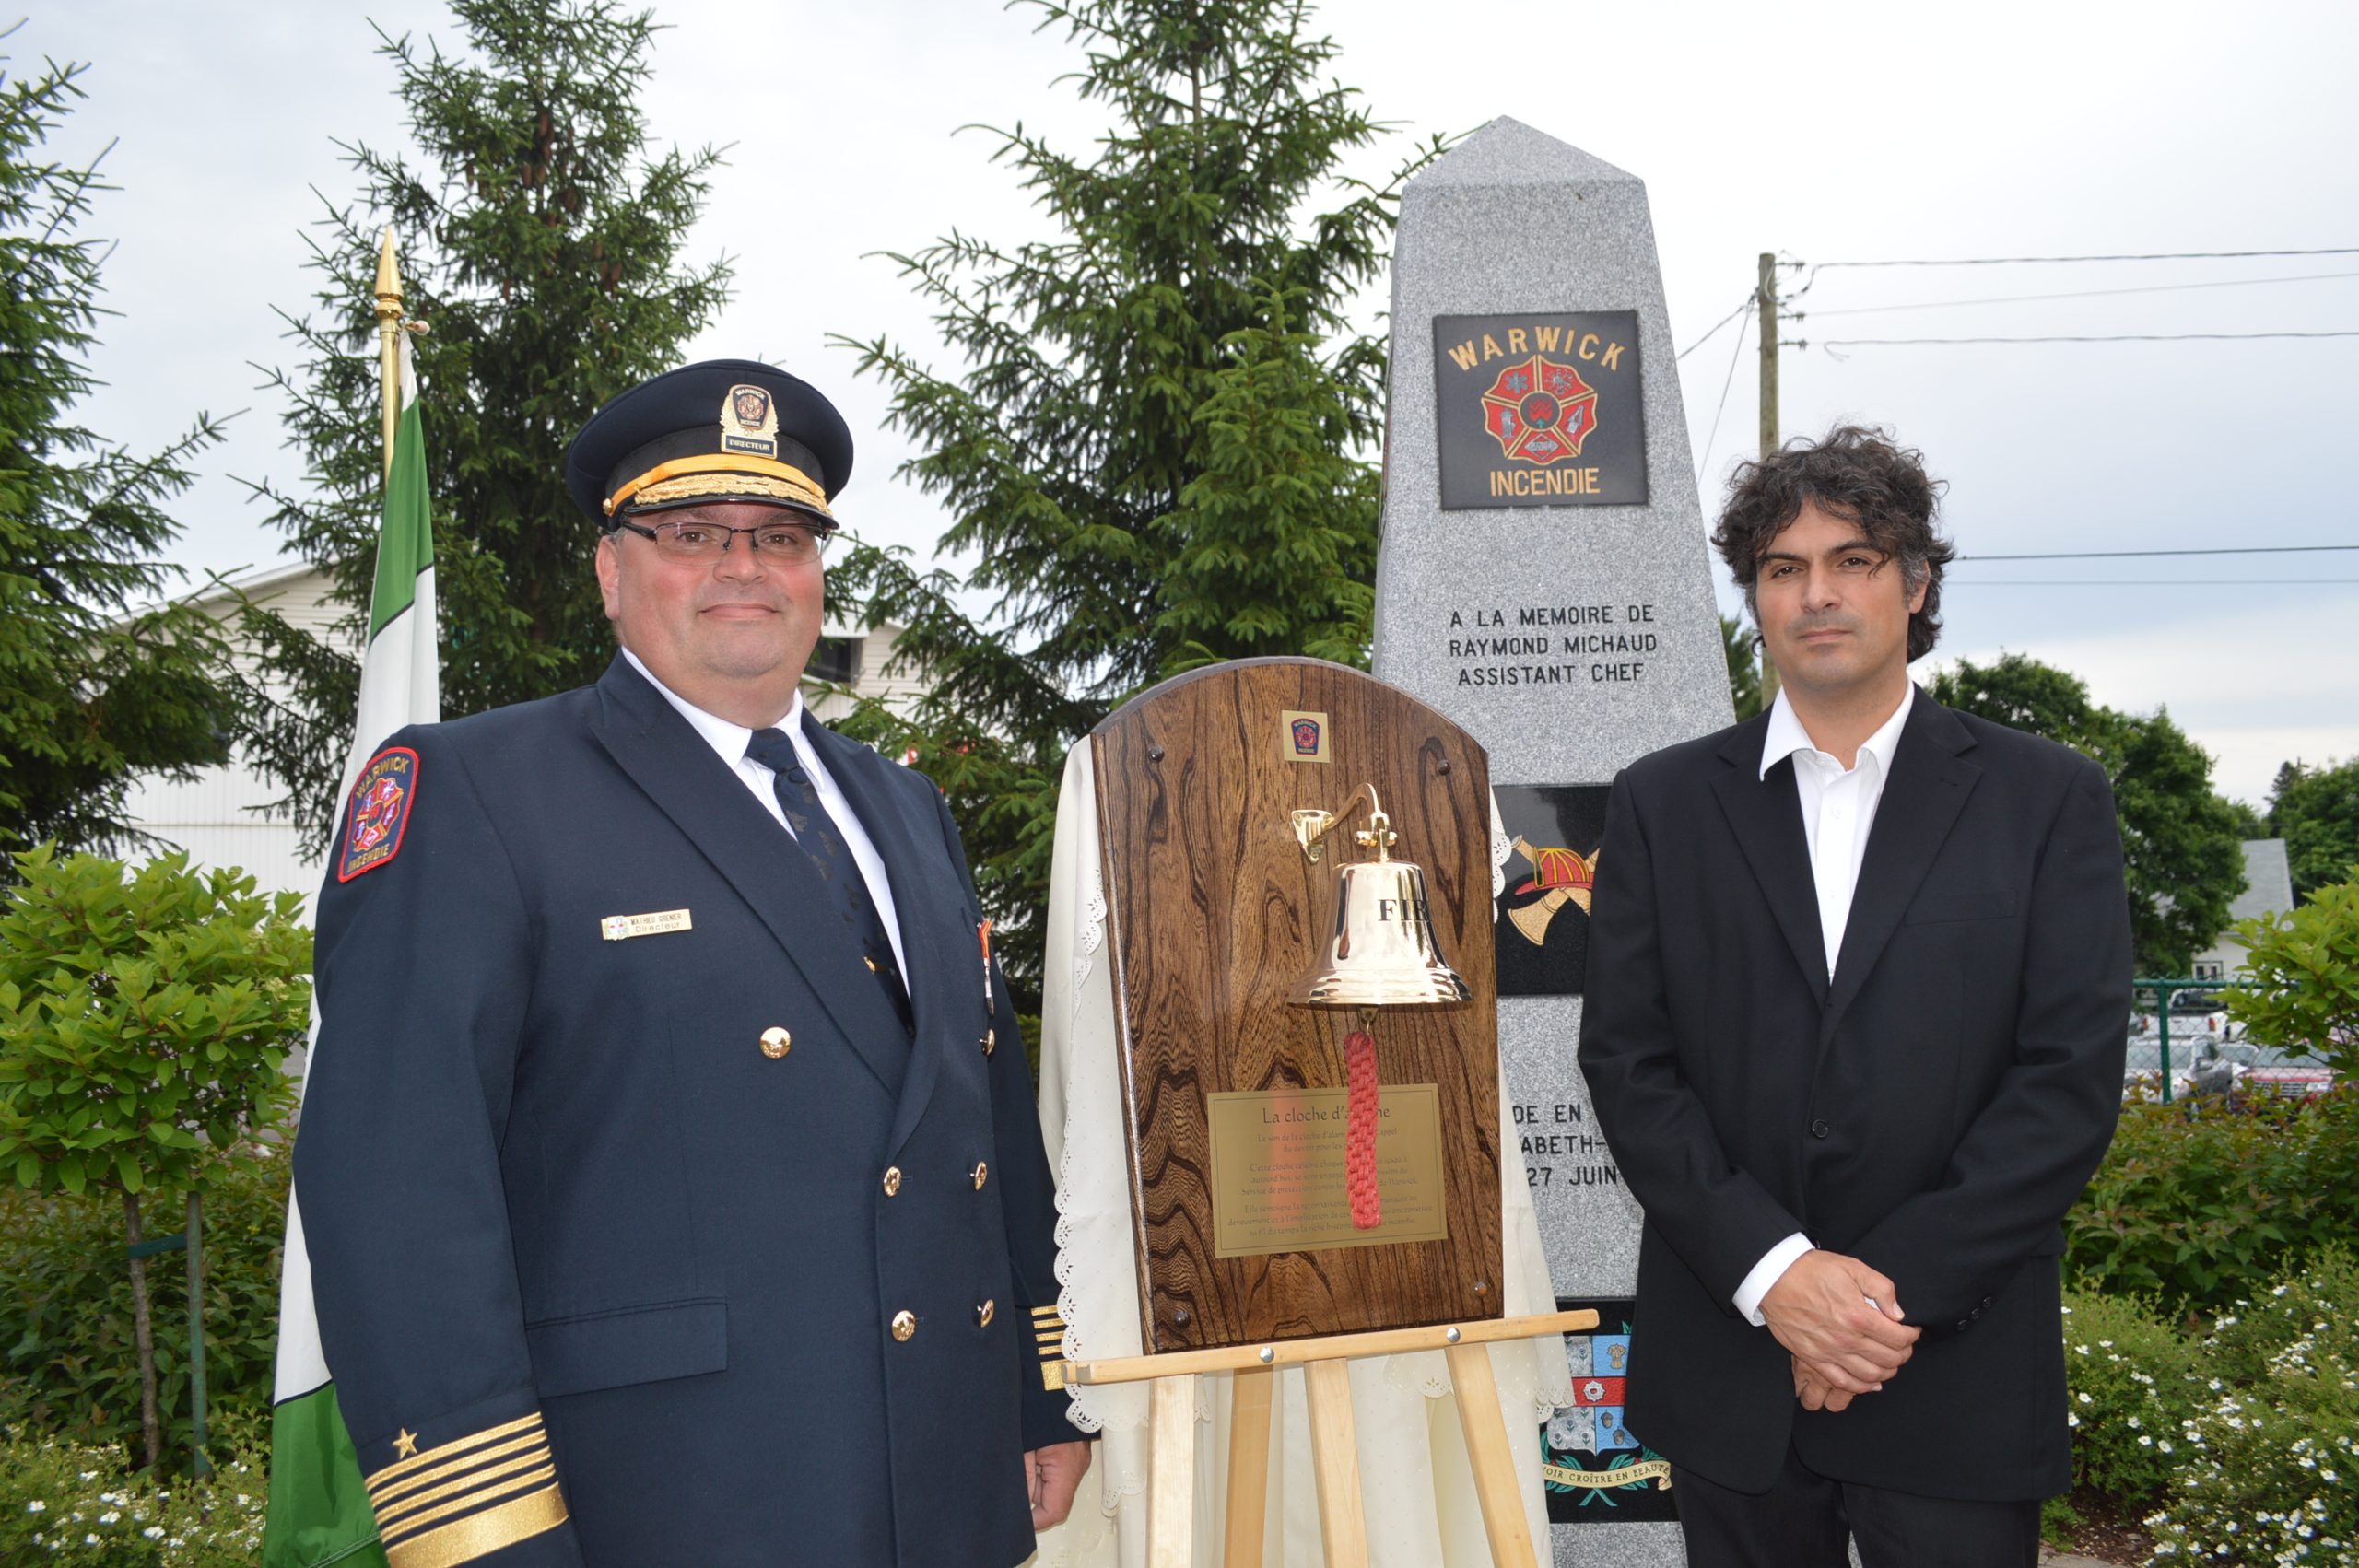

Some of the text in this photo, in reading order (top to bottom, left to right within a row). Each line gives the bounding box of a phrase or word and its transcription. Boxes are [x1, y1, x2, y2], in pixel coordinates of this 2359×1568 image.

[1448, 325, 1626, 371] WARWICK
[1490, 467, 1601, 497] INCENDIE
[1449, 604, 1654, 628] A LA MEMOIRE DE
[1449, 634, 1658, 657] RAYMOND MICHAUD
[1458, 663, 1645, 686] ASSISTANT CHEF
[356, 756, 409, 799] WARWICK
[347, 843, 390, 872] INCENDIE
[1262, 1107, 1280, 1123] La
[1285, 1106, 1328, 1122] cloche
[1555, 1104, 1581, 1123] EN
[1526, 1165, 1617, 1187] 27 JUIN
[1616, 1472, 1629, 1482] EN
